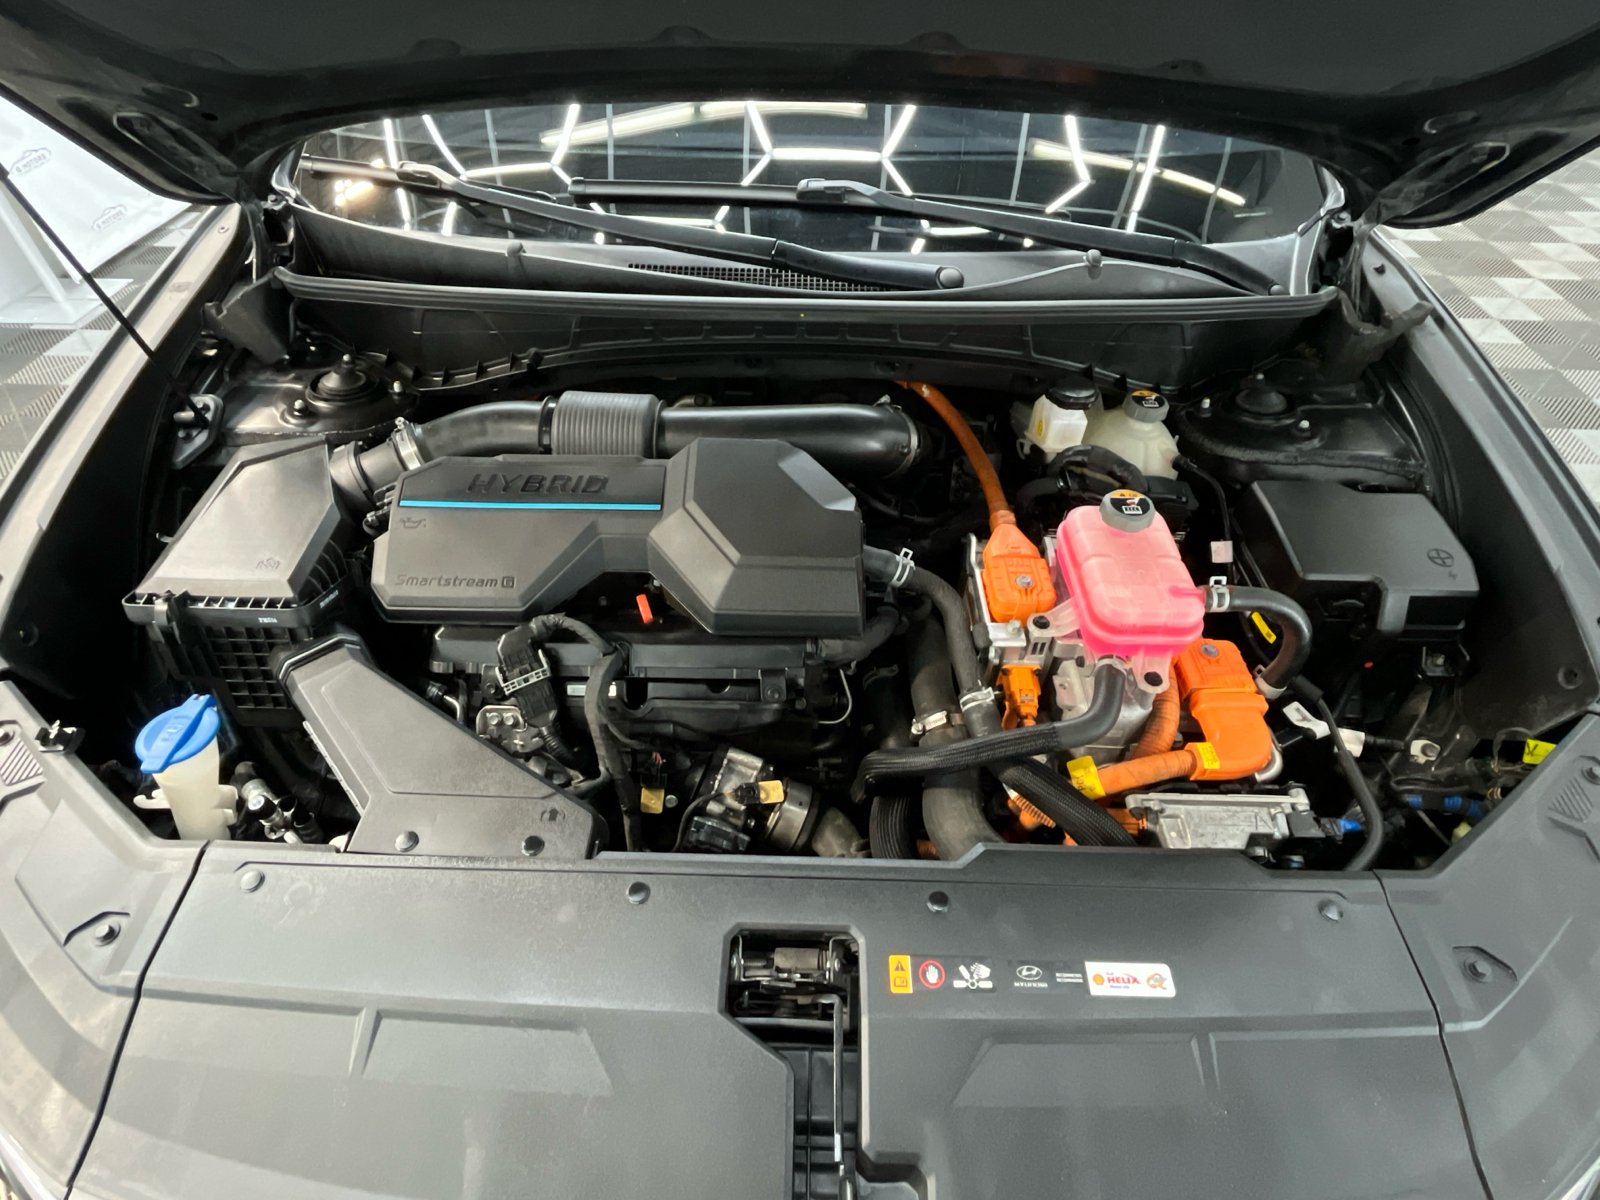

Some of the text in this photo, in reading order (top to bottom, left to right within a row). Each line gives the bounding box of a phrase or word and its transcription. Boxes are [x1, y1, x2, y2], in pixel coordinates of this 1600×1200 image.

[23, 153, 46, 169] MOTORS
[102, 210, 123, 226] MOTORS
[465, 473, 609, 494] HYBRID
[395, 574, 515, 588] Smartstream G
[1107, 975, 1140, 984] HELIX
